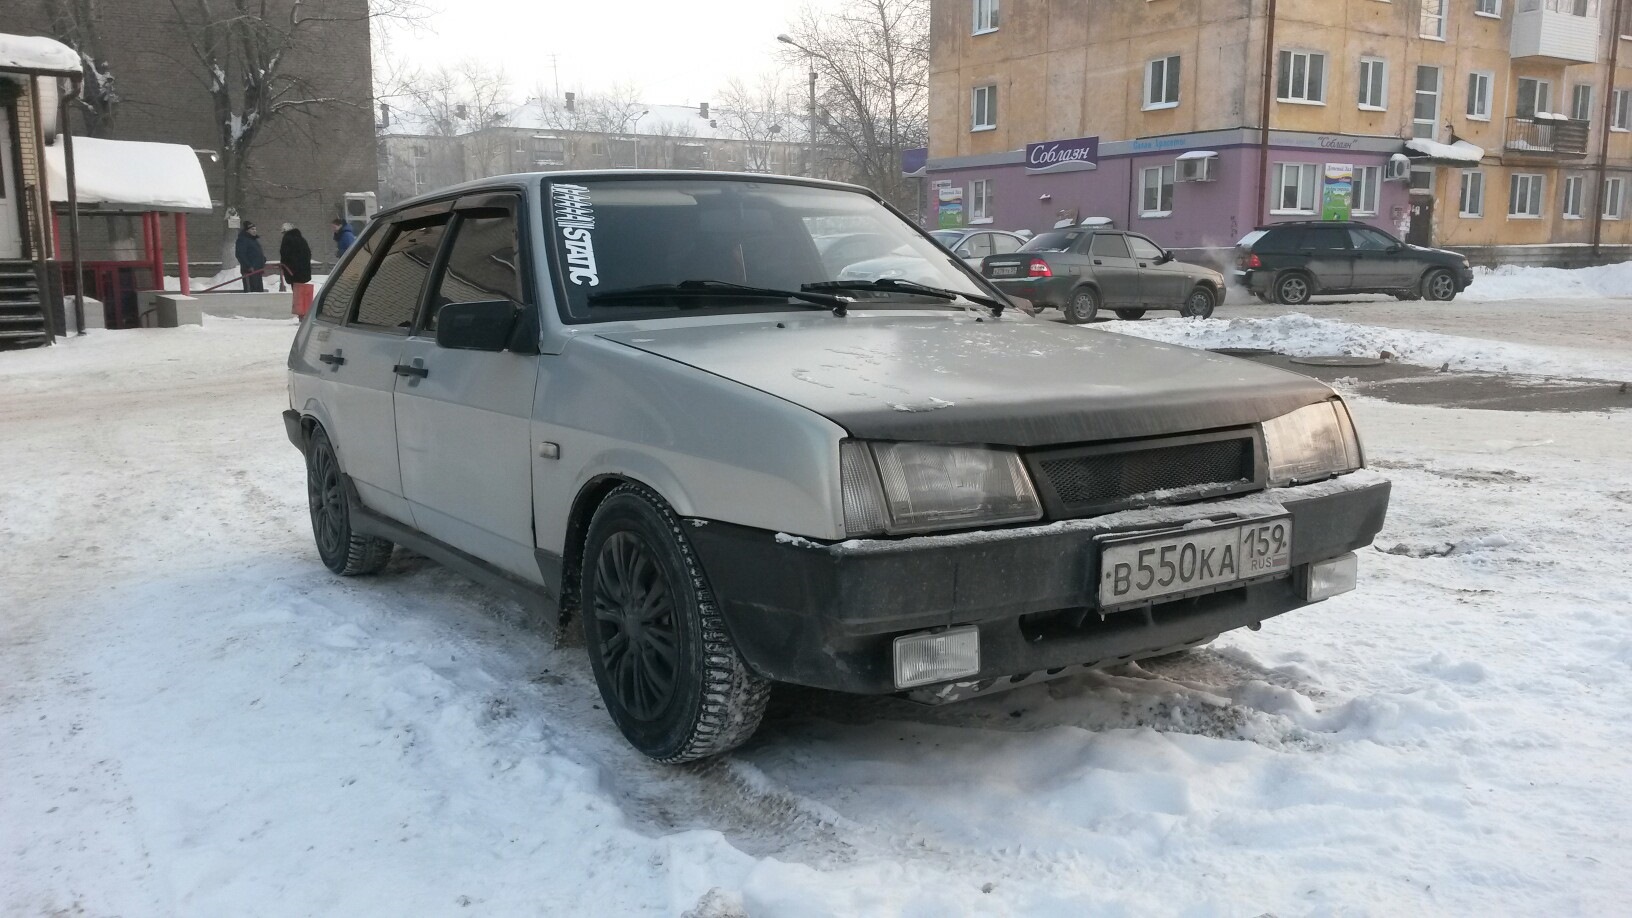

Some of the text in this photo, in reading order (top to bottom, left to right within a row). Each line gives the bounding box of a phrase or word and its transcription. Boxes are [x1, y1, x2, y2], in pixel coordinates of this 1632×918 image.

[1030, 143, 1090, 164] Соблазн
[562, 227, 599, 287] STATIC
[1243, 523, 1285, 558] 159
[1251, 556, 1272, 571] RUS
